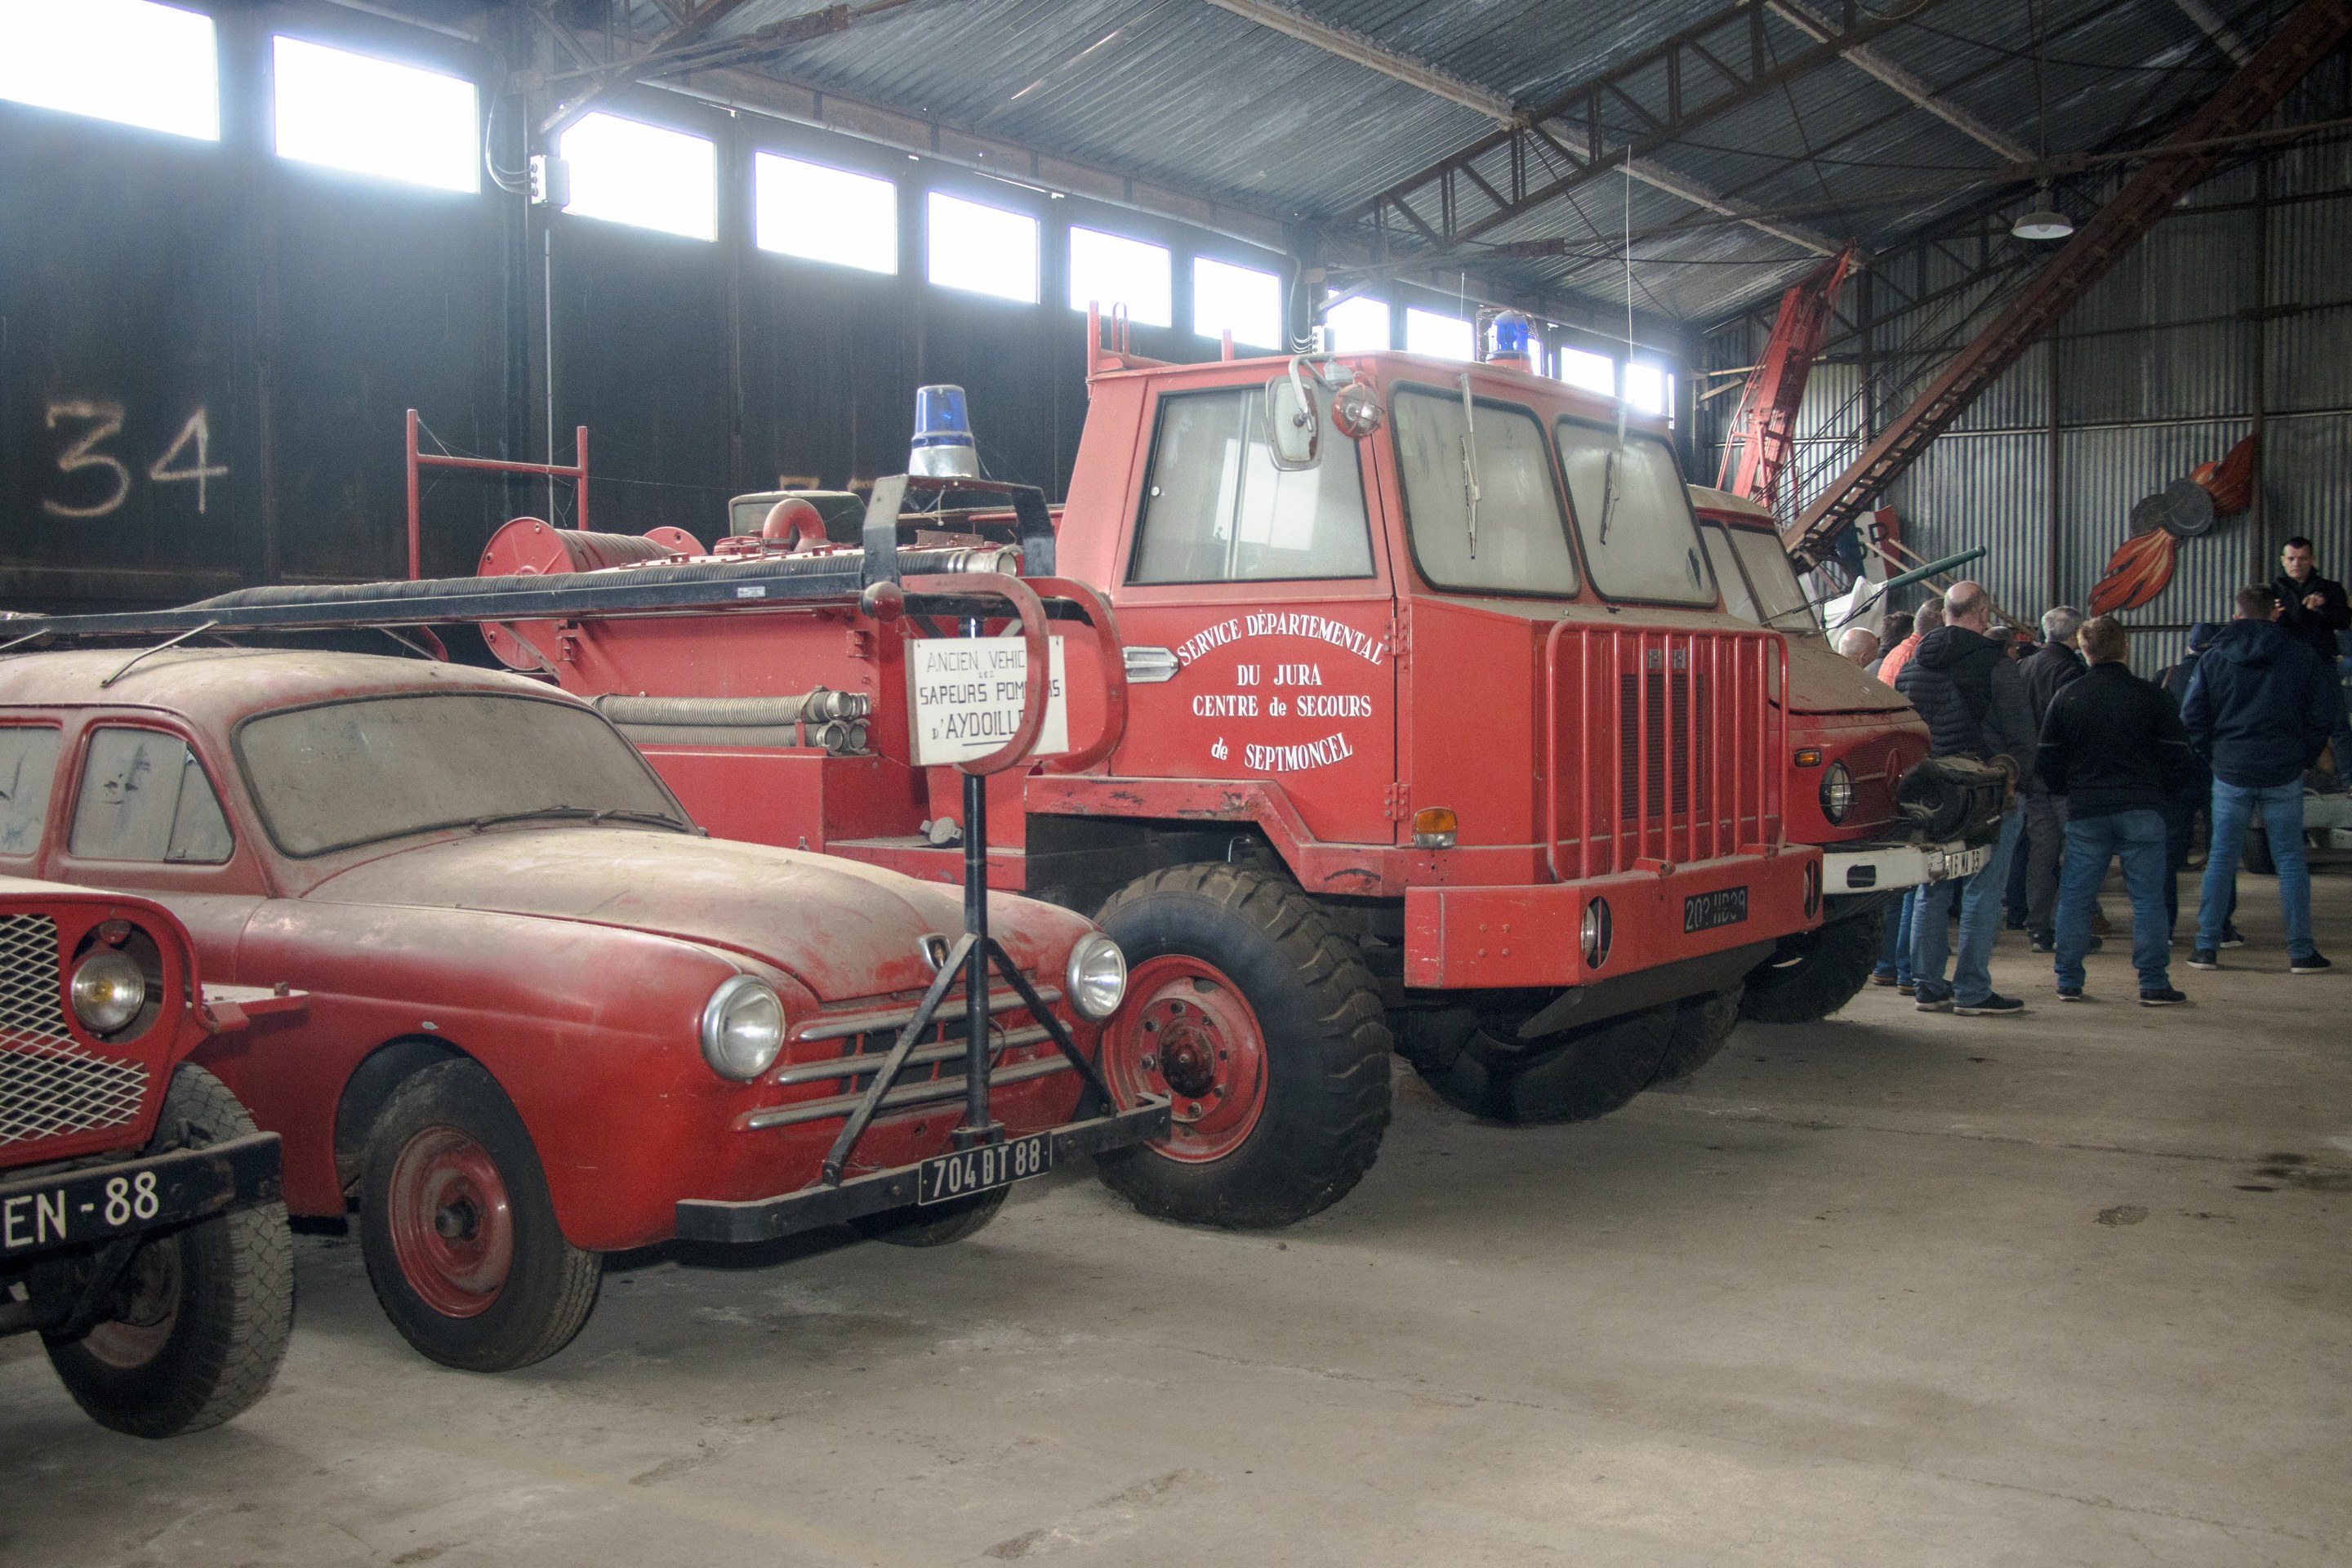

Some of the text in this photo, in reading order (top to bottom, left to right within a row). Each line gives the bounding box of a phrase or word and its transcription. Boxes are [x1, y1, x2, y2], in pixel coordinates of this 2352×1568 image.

[43, 402, 228, 516] 34
[1177, 619, 1242, 666] SERVICE
[926, 650, 1027, 672] ANCIEN VEHIC
[1236, 663, 1323, 686] DU JURA
[920, 684, 987, 705] SAPEURS
[1192, 696, 1372, 717] CENTRE de SECOURS
[1211, 733, 1353, 773] de SEPTMONCEL
[933, 1153, 977, 1197] 704
[1015, 1138, 1041, 1176] 88
